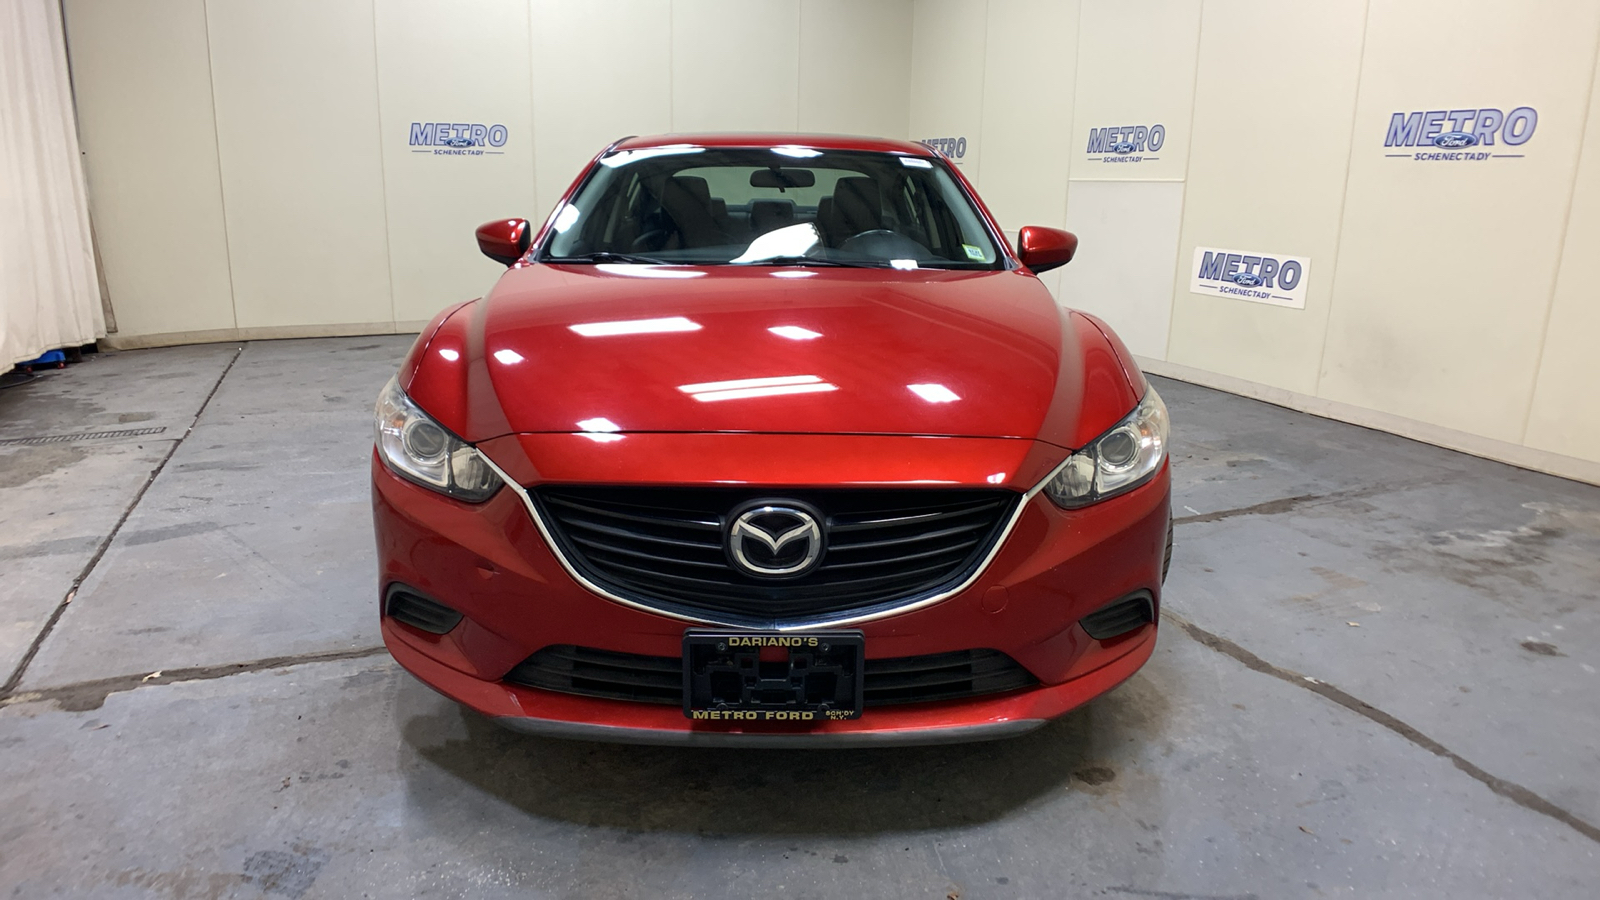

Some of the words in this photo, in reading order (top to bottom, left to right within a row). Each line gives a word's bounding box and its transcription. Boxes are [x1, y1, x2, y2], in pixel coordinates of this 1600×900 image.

[1384, 107, 1538, 147] METRO
[409, 122, 508, 147] METRO
[1087, 124, 1165, 153] METRO
[450, 139, 468, 147] Ford
[1441, 135, 1468, 147] Ford
[921, 137, 967, 158] ETRO
[1414, 152, 1491, 161] SCHENECTADY
[1198, 251, 1302, 291] METRO
[1237, 275, 1256, 285] Ford
[1219, 286, 1271, 299] SCHENECTADY
[728, 637, 819, 647] DARIANO'S
[693, 711, 758, 720] METRO
[765, 711, 814, 720] FORD
